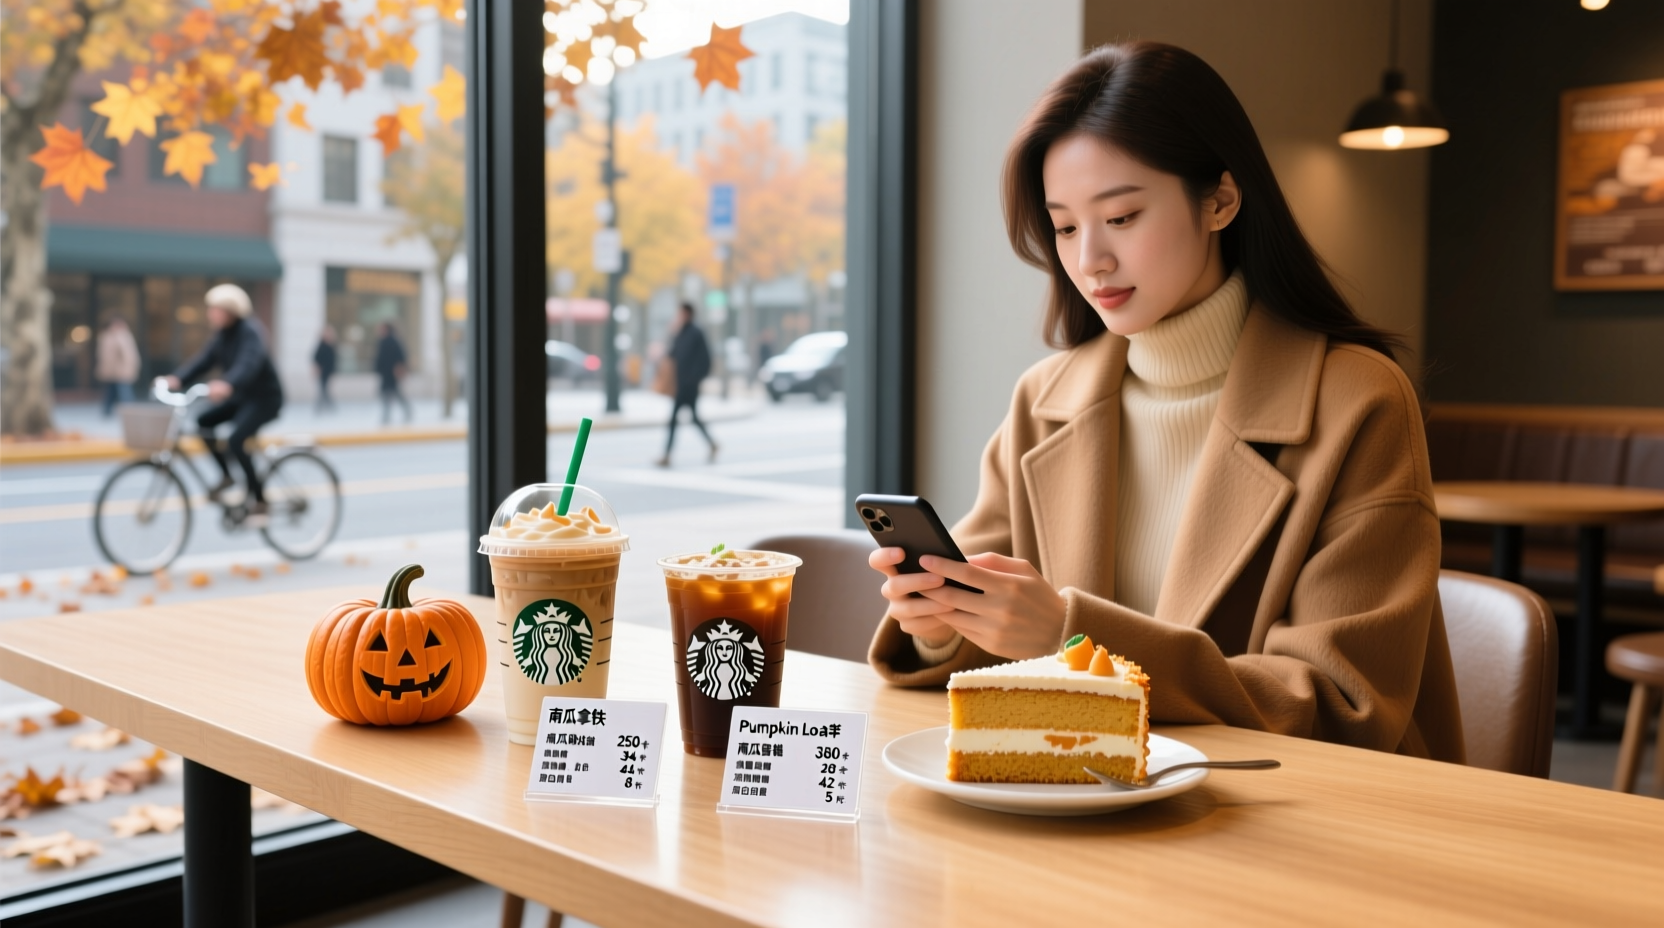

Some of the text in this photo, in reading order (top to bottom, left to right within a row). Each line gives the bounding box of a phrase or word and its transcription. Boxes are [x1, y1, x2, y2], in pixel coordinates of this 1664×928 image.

[739, 719, 798, 738] Pumpkin
[617, 735, 640, 748] 250
[815, 746, 840, 759] 380
[624, 777, 633, 788] 8
[818, 776, 835, 788] 42
[825, 791, 833, 803] 5
